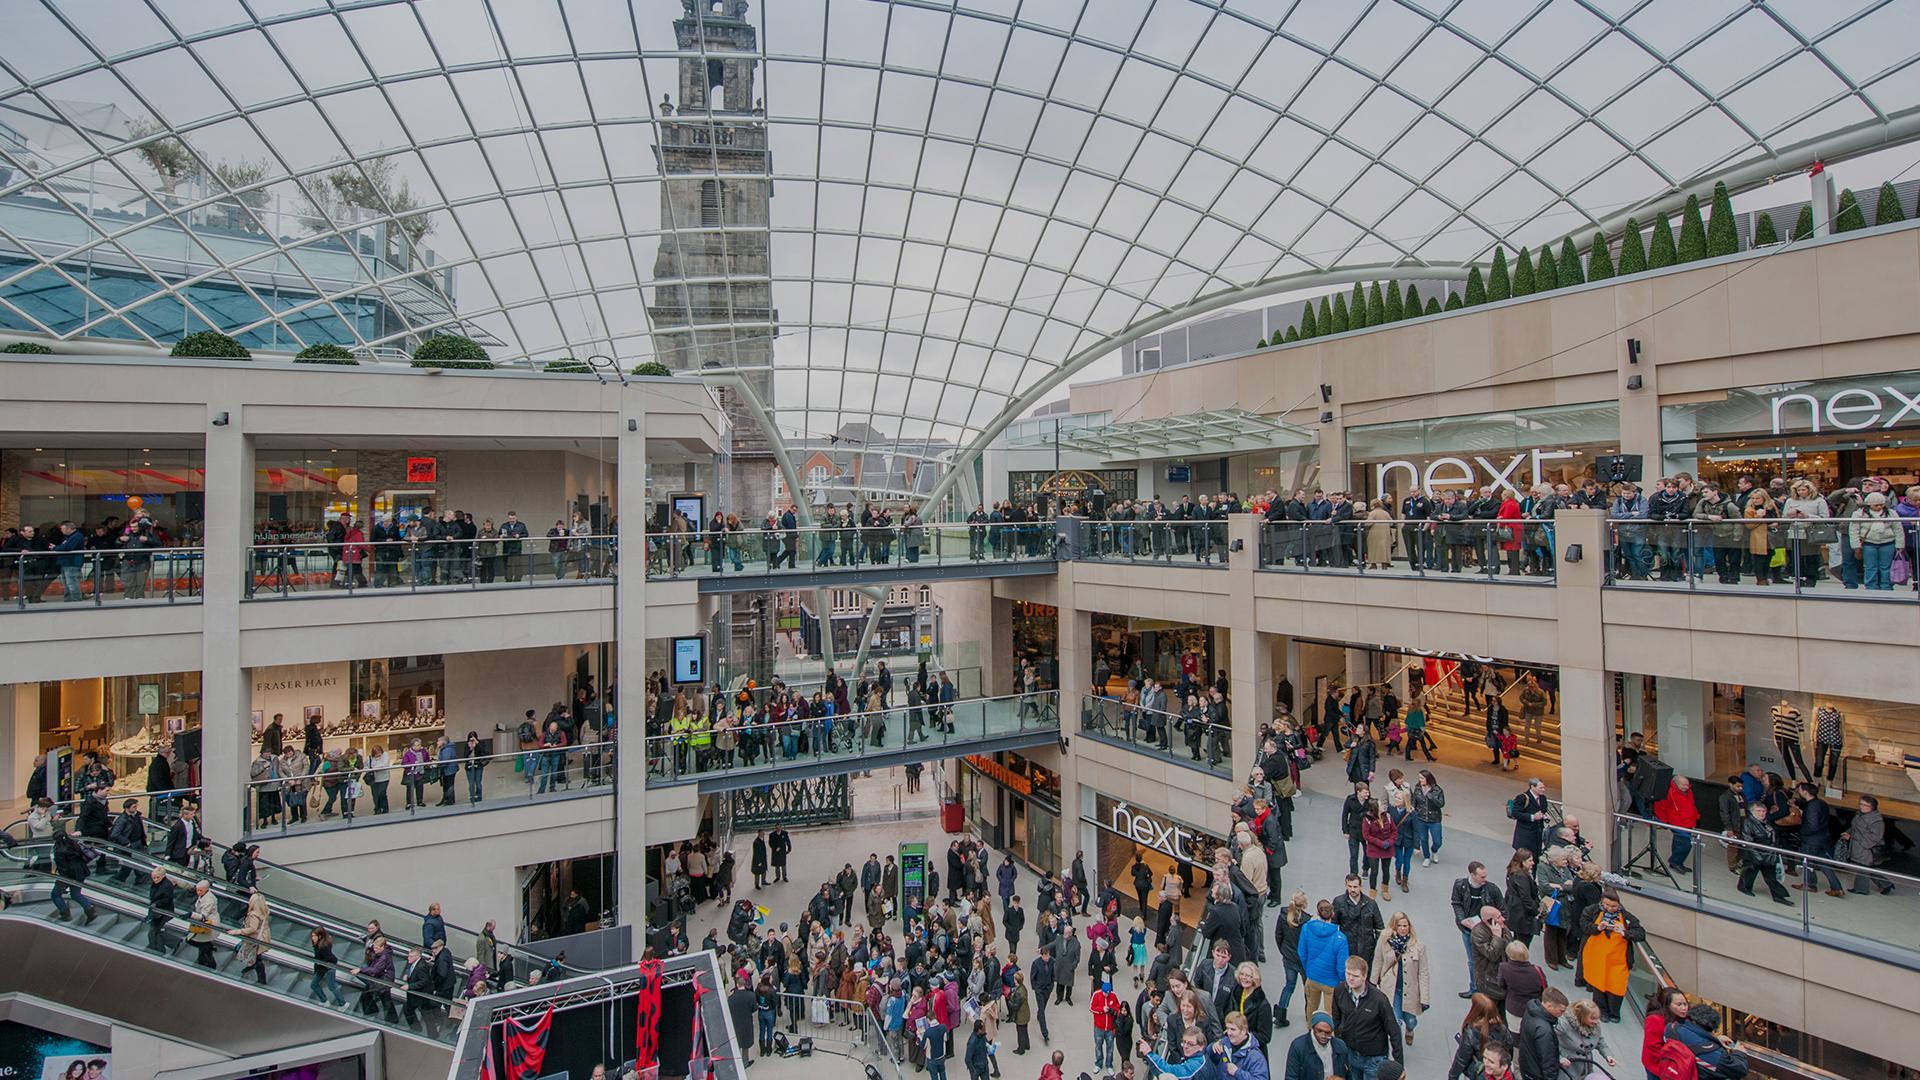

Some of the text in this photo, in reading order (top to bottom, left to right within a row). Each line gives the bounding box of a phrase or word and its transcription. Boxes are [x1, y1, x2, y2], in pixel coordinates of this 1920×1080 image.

[1376, 449, 1574, 504] next
[1023, 603, 1058, 617] URB
[256, 678, 338, 691] FRASER HART
[979, 756, 1031, 795] OUTFITTERS
[1113, 803, 1193, 862] next
